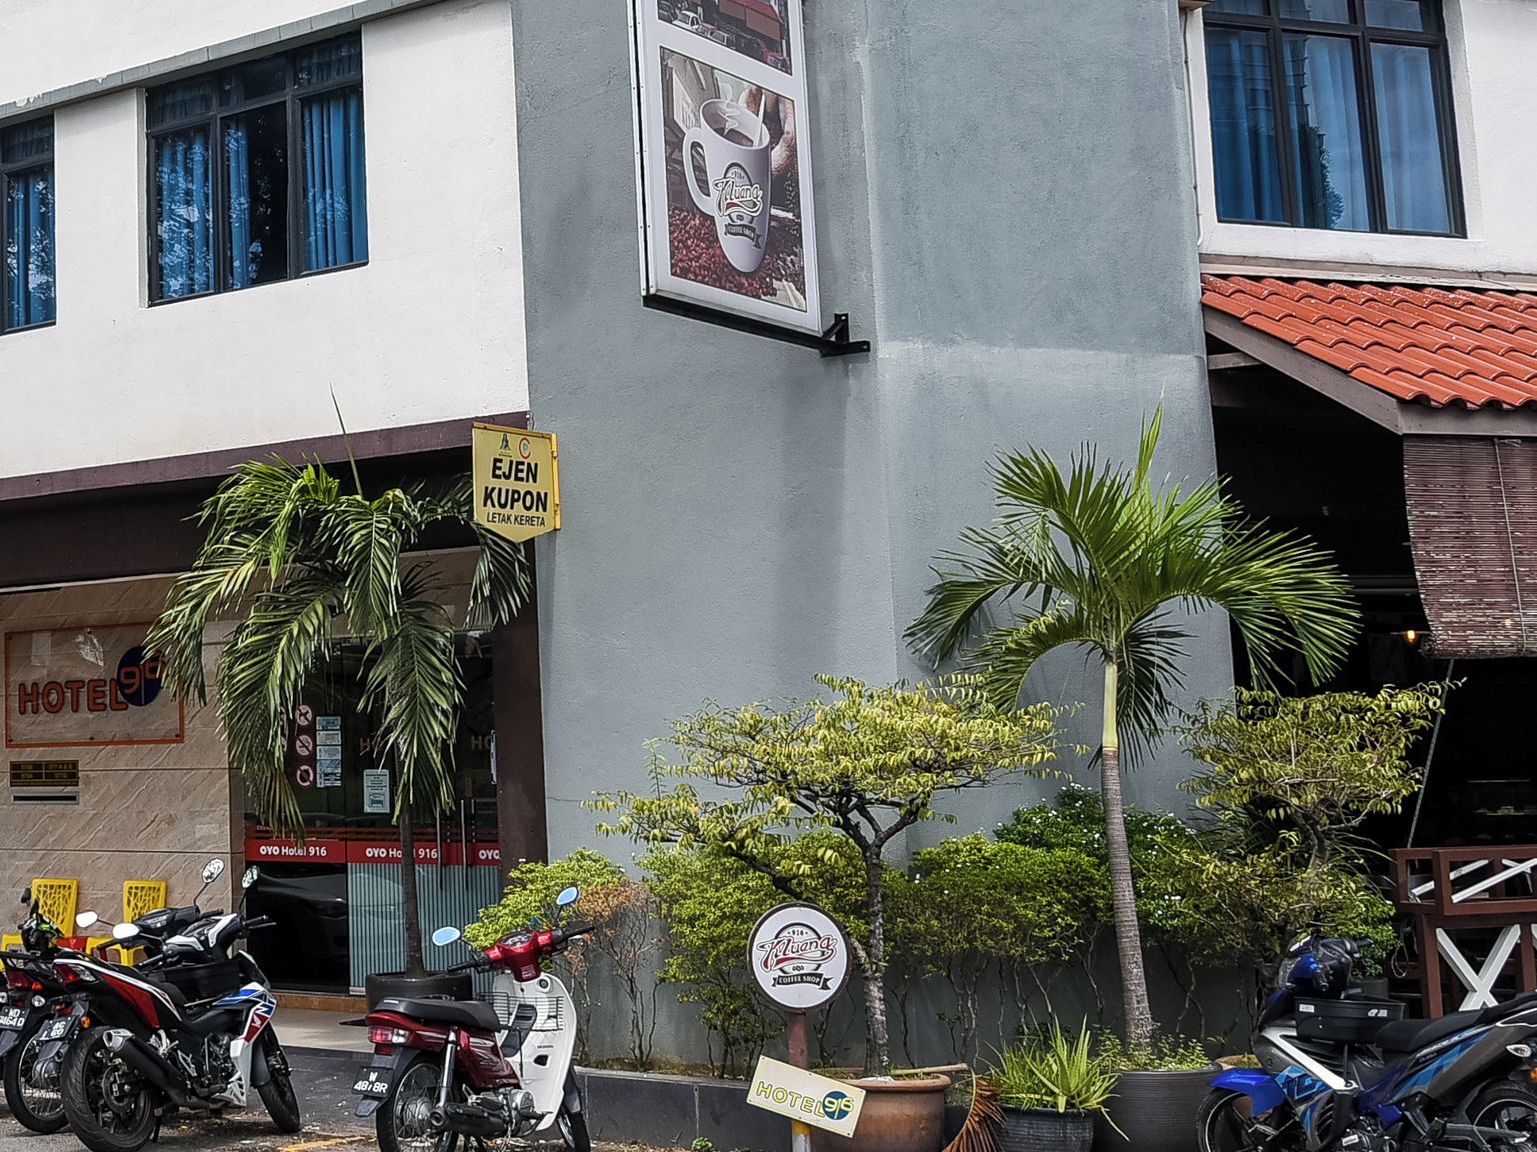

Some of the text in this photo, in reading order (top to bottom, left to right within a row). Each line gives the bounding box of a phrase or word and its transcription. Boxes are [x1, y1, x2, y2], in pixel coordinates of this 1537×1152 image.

[492, 457, 538, 484] EJEN
[483, 486, 548, 513] KUPON
[487, 511, 546, 527] LETAK KERETA
[18, 678, 128, 715] HOTEL
[259, 845, 280, 856] OYO
[309, 846, 327, 857] 916
[366, 847, 387, 858] OYO
[418, 849, 438, 859] 916
[791, 928, 804, 937] 916
[778, 975, 821, 984] COFFEE SHOP
[756, 1081, 854, 1119] HOTEL 916
